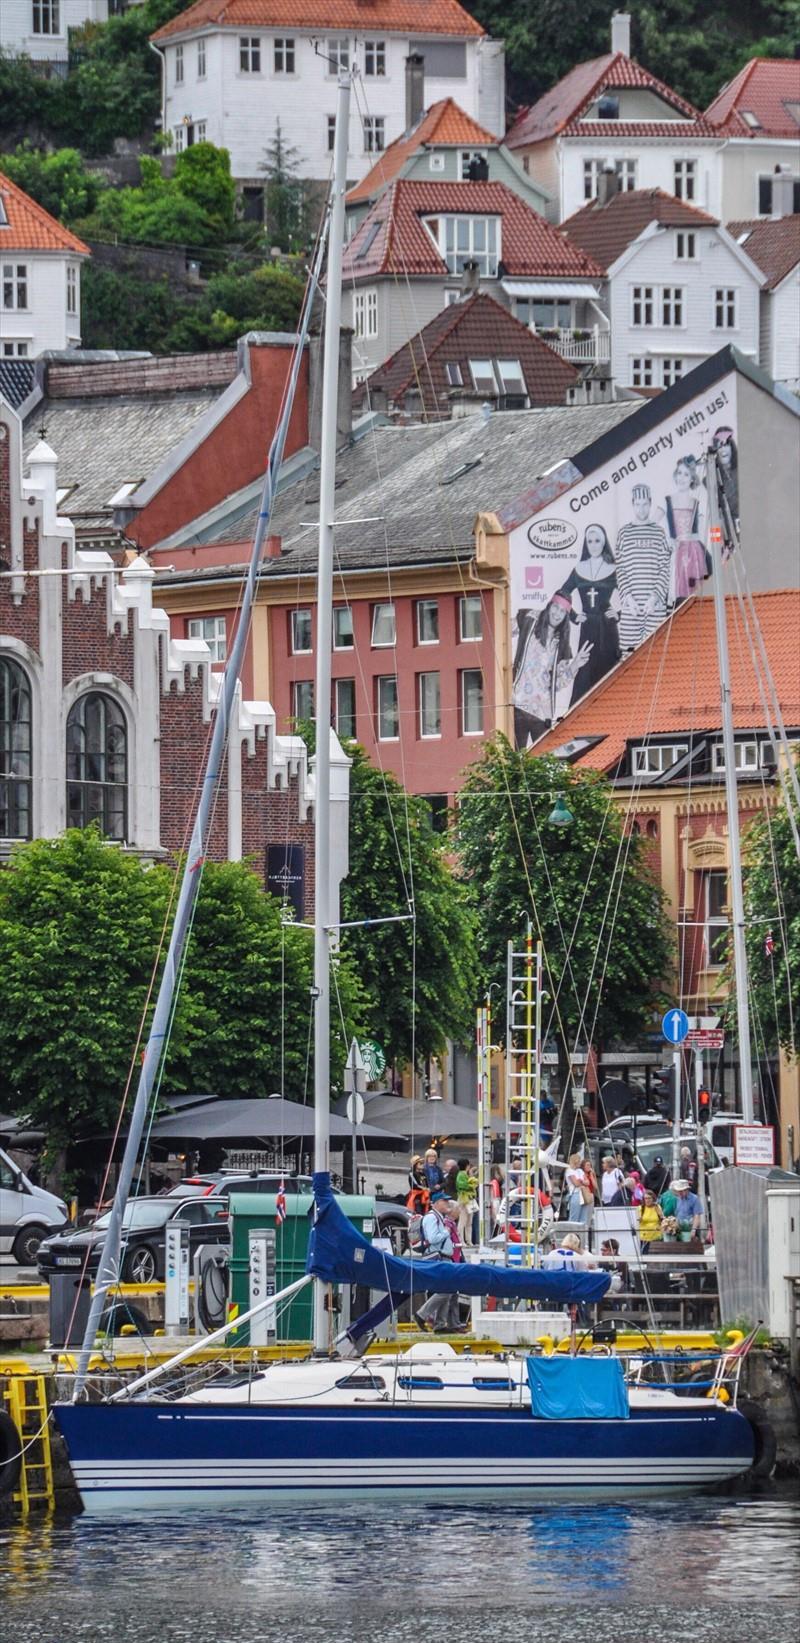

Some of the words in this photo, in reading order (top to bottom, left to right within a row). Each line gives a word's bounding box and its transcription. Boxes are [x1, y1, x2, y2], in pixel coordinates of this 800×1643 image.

[569, 479, 610, 513] Come
[611, 456, 638, 484] and
[638, 433, 674, 467] party
[675, 410, 705, 437] with
[707, 391, 729, 415] us!
[538, 521, 567, 533] ruben's
[533, 534, 575, 548] skattkammer
[521, 592, 548, 602] smiffys
